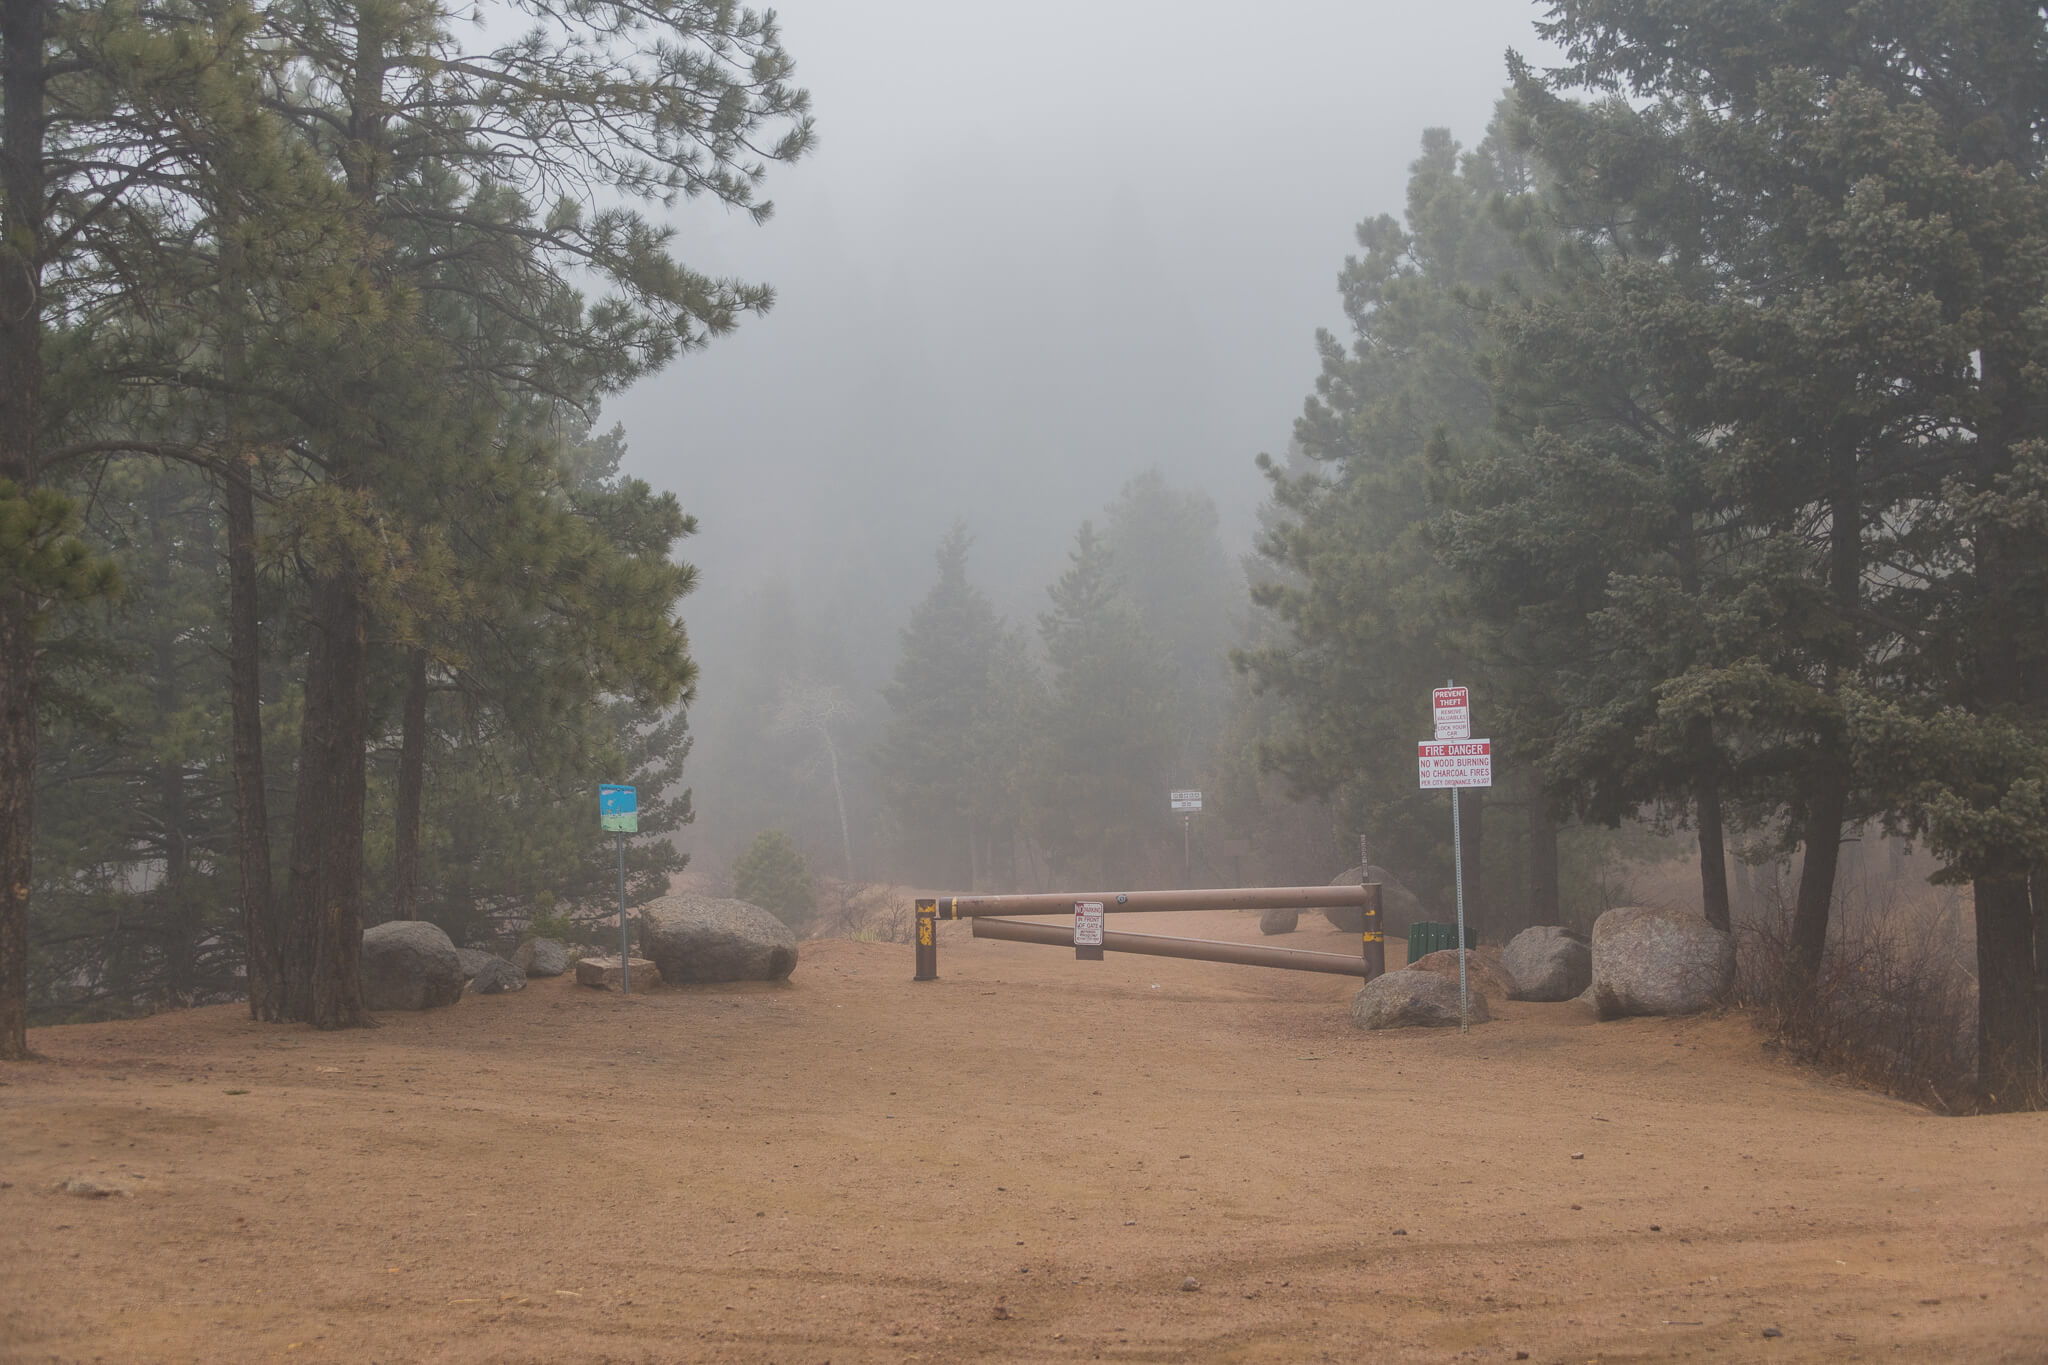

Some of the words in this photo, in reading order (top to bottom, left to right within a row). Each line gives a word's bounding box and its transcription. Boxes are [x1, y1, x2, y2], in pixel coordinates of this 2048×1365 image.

[1435, 690, 1466, 698] PREVENT
[1425, 746, 1444, 756] FIRE
[1448, 744, 1483, 755] DANGER
[1421, 760, 1430, 768] NO
[1434, 759, 1454, 767] WOOD
[1457, 757, 1489, 767] BURNING
[1421, 770, 1430, 778] NO
[1433, 769, 1468, 778] CHARCOAL
[1076, 905, 1084, 914] NO
